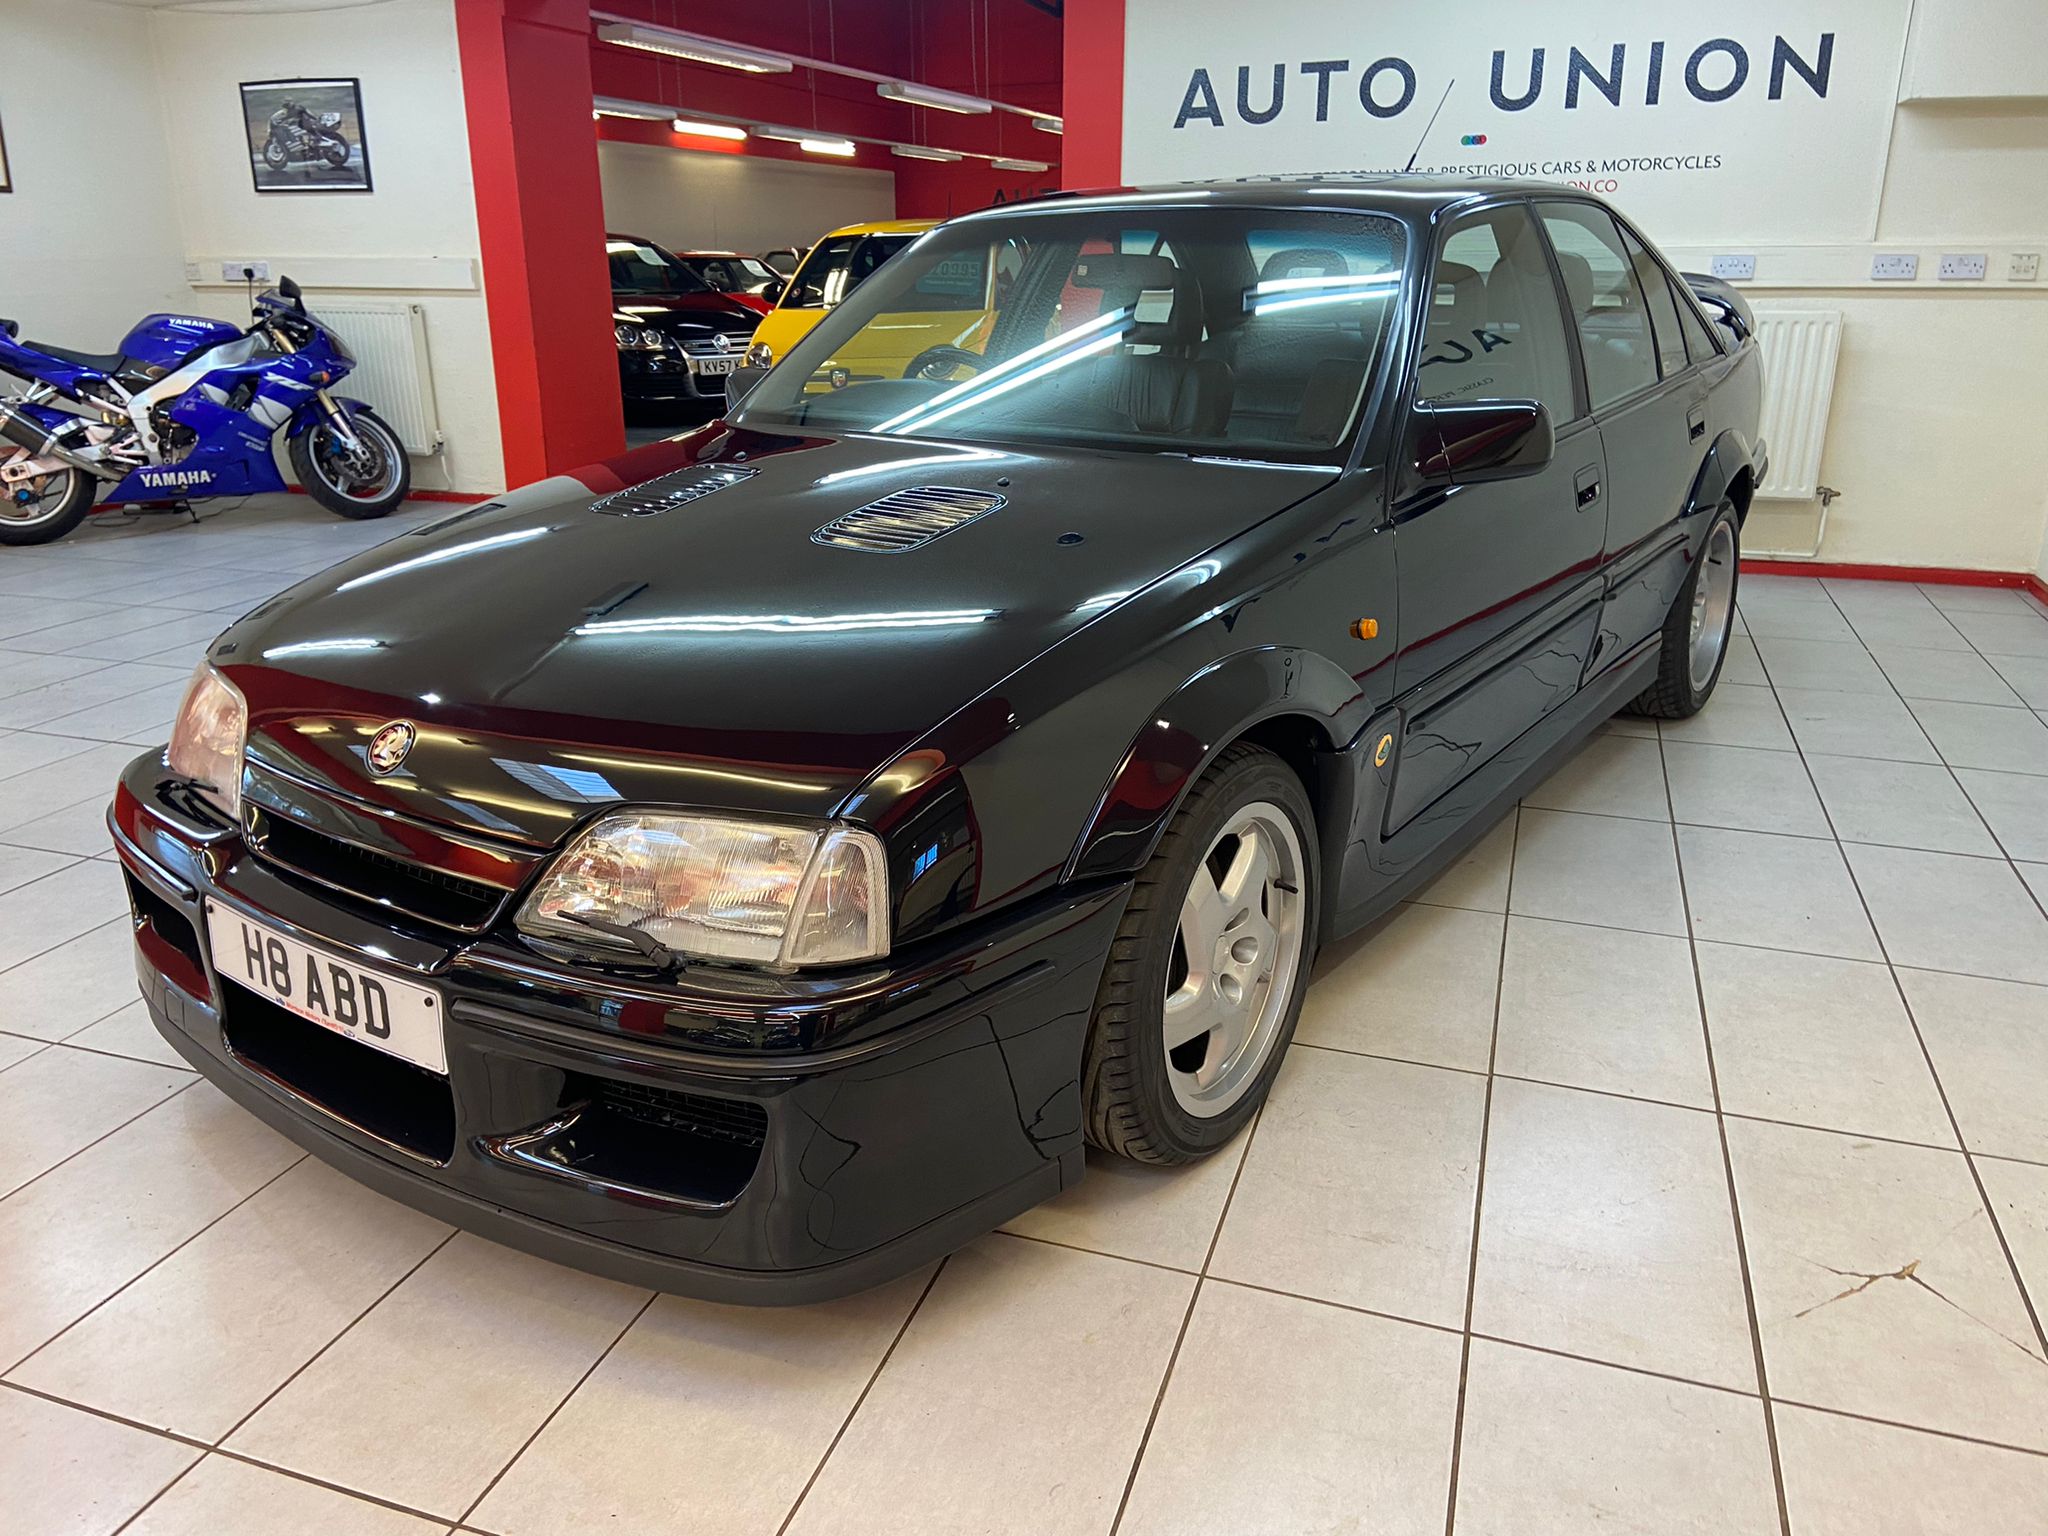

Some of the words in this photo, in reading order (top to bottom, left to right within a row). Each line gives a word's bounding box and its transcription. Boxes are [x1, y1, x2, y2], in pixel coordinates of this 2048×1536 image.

[1173, 56, 1417, 130] AUTO
[1489, 33, 1835, 112] UNION
[1441, 163, 1537, 177] PRESTIGIOUS
[1541, 161, 1582, 175] CARS
[1586, 161, 1596, 173] &
[1601, 155, 1721, 173] MOTORCYCLES
[169, 318, 215, 330] YAMAHA
[704, 360, 732, 373] KV57
[140, 470, 212, 488] YAMAHA
[241, 922, 292, 998] H8
[306, 953, 391, 1040] ABD
